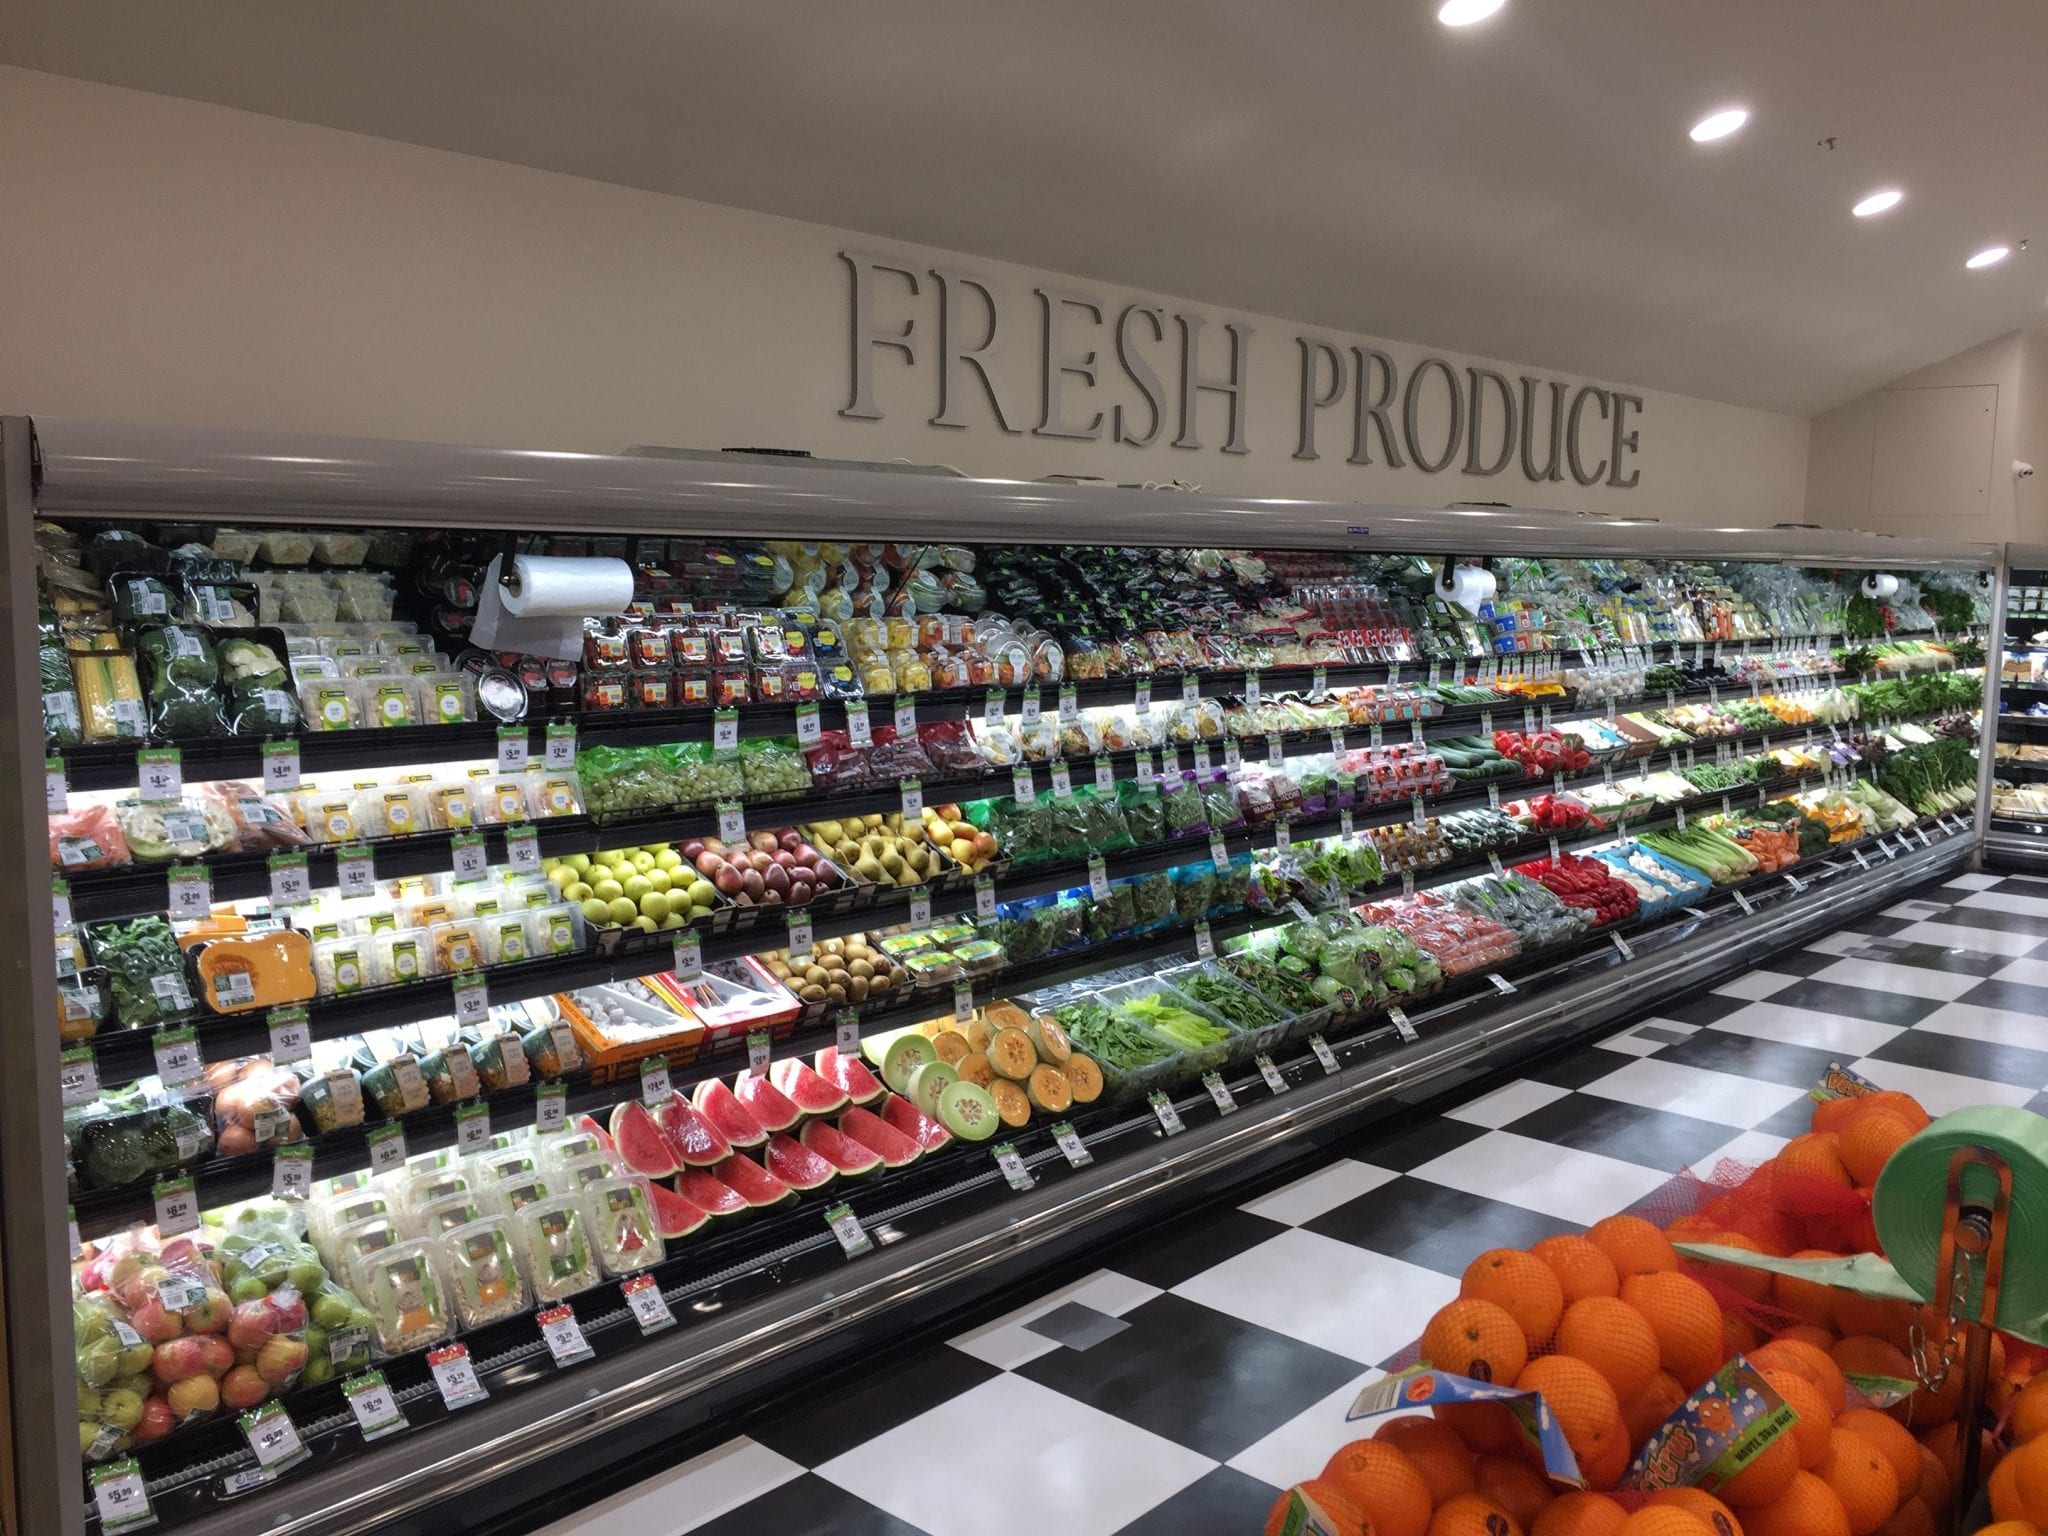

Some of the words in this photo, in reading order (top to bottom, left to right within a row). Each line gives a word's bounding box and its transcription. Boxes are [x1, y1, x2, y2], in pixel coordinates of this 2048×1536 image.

[837, 250, 1256, 456] FRESH
[1293, 336, 1643, 489] PRODUCE
[1735, 1439, 1761, 1463] NAVEL
